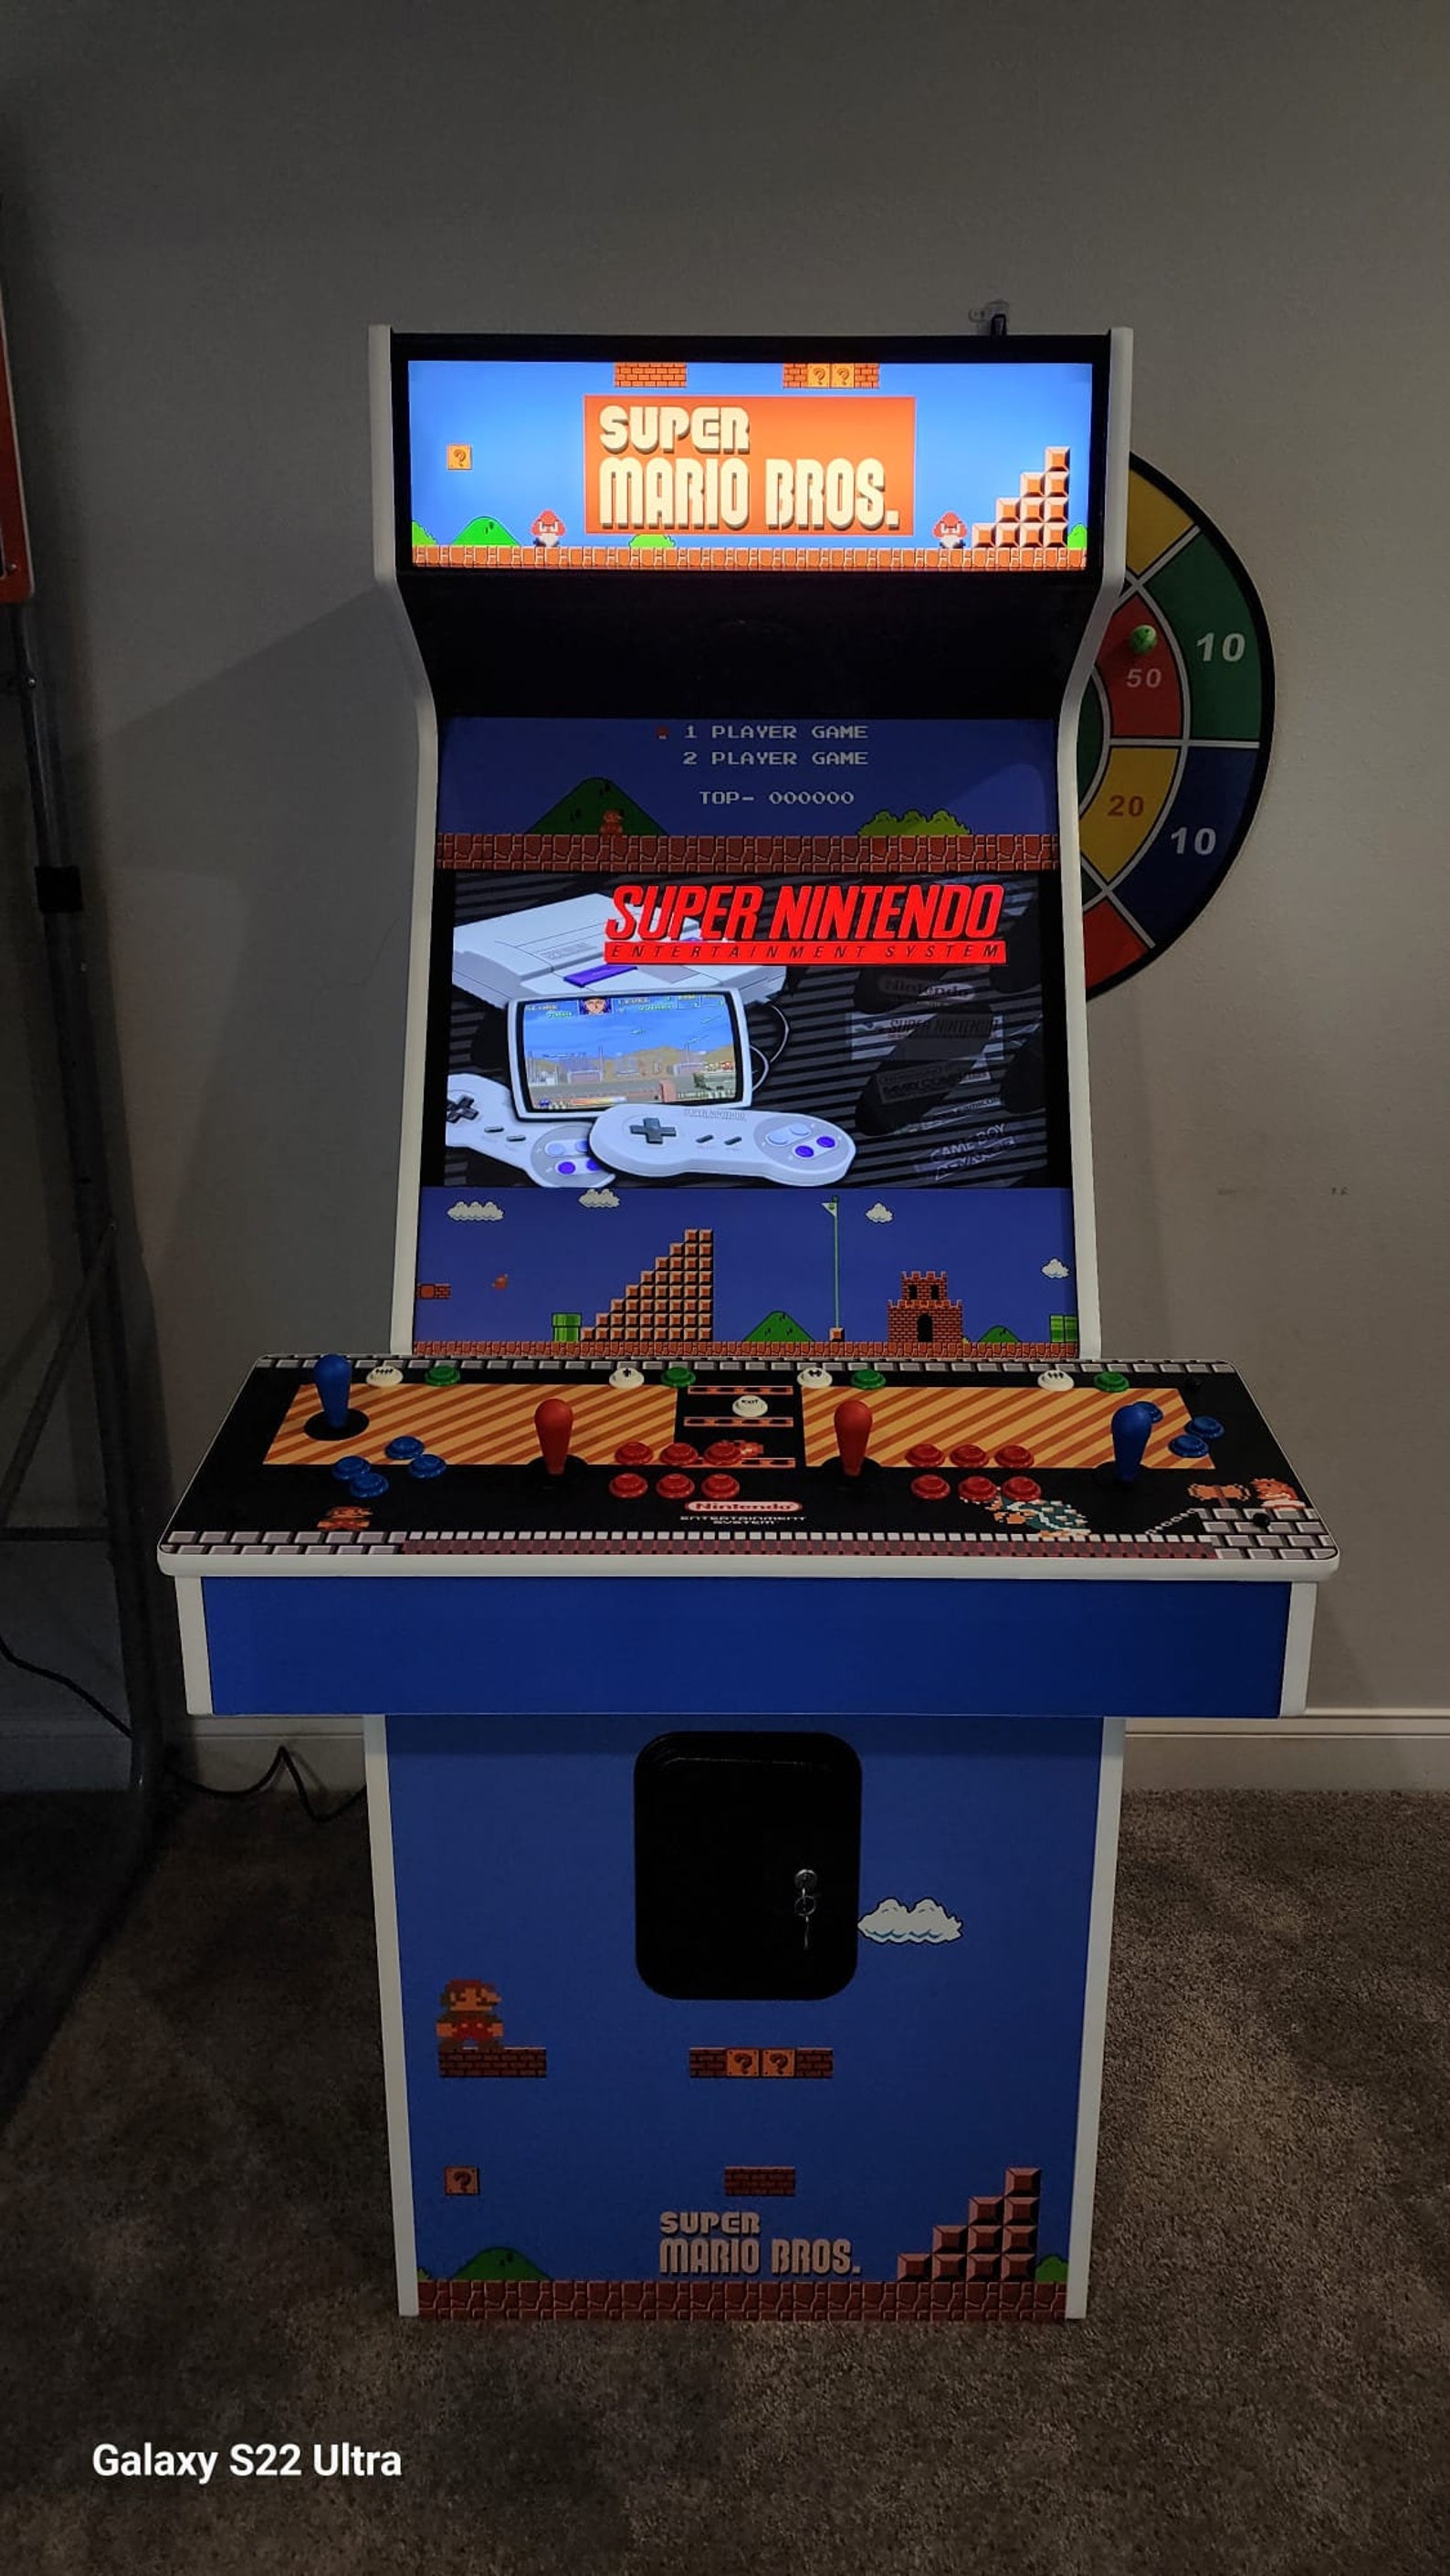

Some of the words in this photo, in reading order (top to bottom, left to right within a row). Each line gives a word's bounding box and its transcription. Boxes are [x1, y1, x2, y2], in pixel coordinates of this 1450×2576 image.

[599, 405, 750, 454] SUPER
[599, 457, 749, 530] MARIO
[765, 457, 900, 530] BROS.
[1196, 632, 1245, 663] 10
[1126, 668, 1162, 689] 50
[685, 725, 698, 739] 1
[711, 725, 797, 739] PLAYER
[812, 725, 868, 739] GAME
[683, 752, 698, 765] 2
[711, 752, 797, 765] PLAYER
[812, 752, 868, 765] GAME
[699, 791, 754, 804] TOP-
[1108, 795, 1144, 816] 20
[1171, 826, 1216, 856] 10
[605, 885, 765, 941] SUPER
[769, 884, 1004, 941] NINTENDO
[611, 945, 867, 959] ENTERTAINMENT
[885, 944, 999, 959] SYSTEM
[695, 1502, 792, 1510] Nintendo
[659, 2211, 761, 2235] SUPER
[659, 2238, 761, 2275] MARIO
[772, 2238, 862, 2275] BROS.
